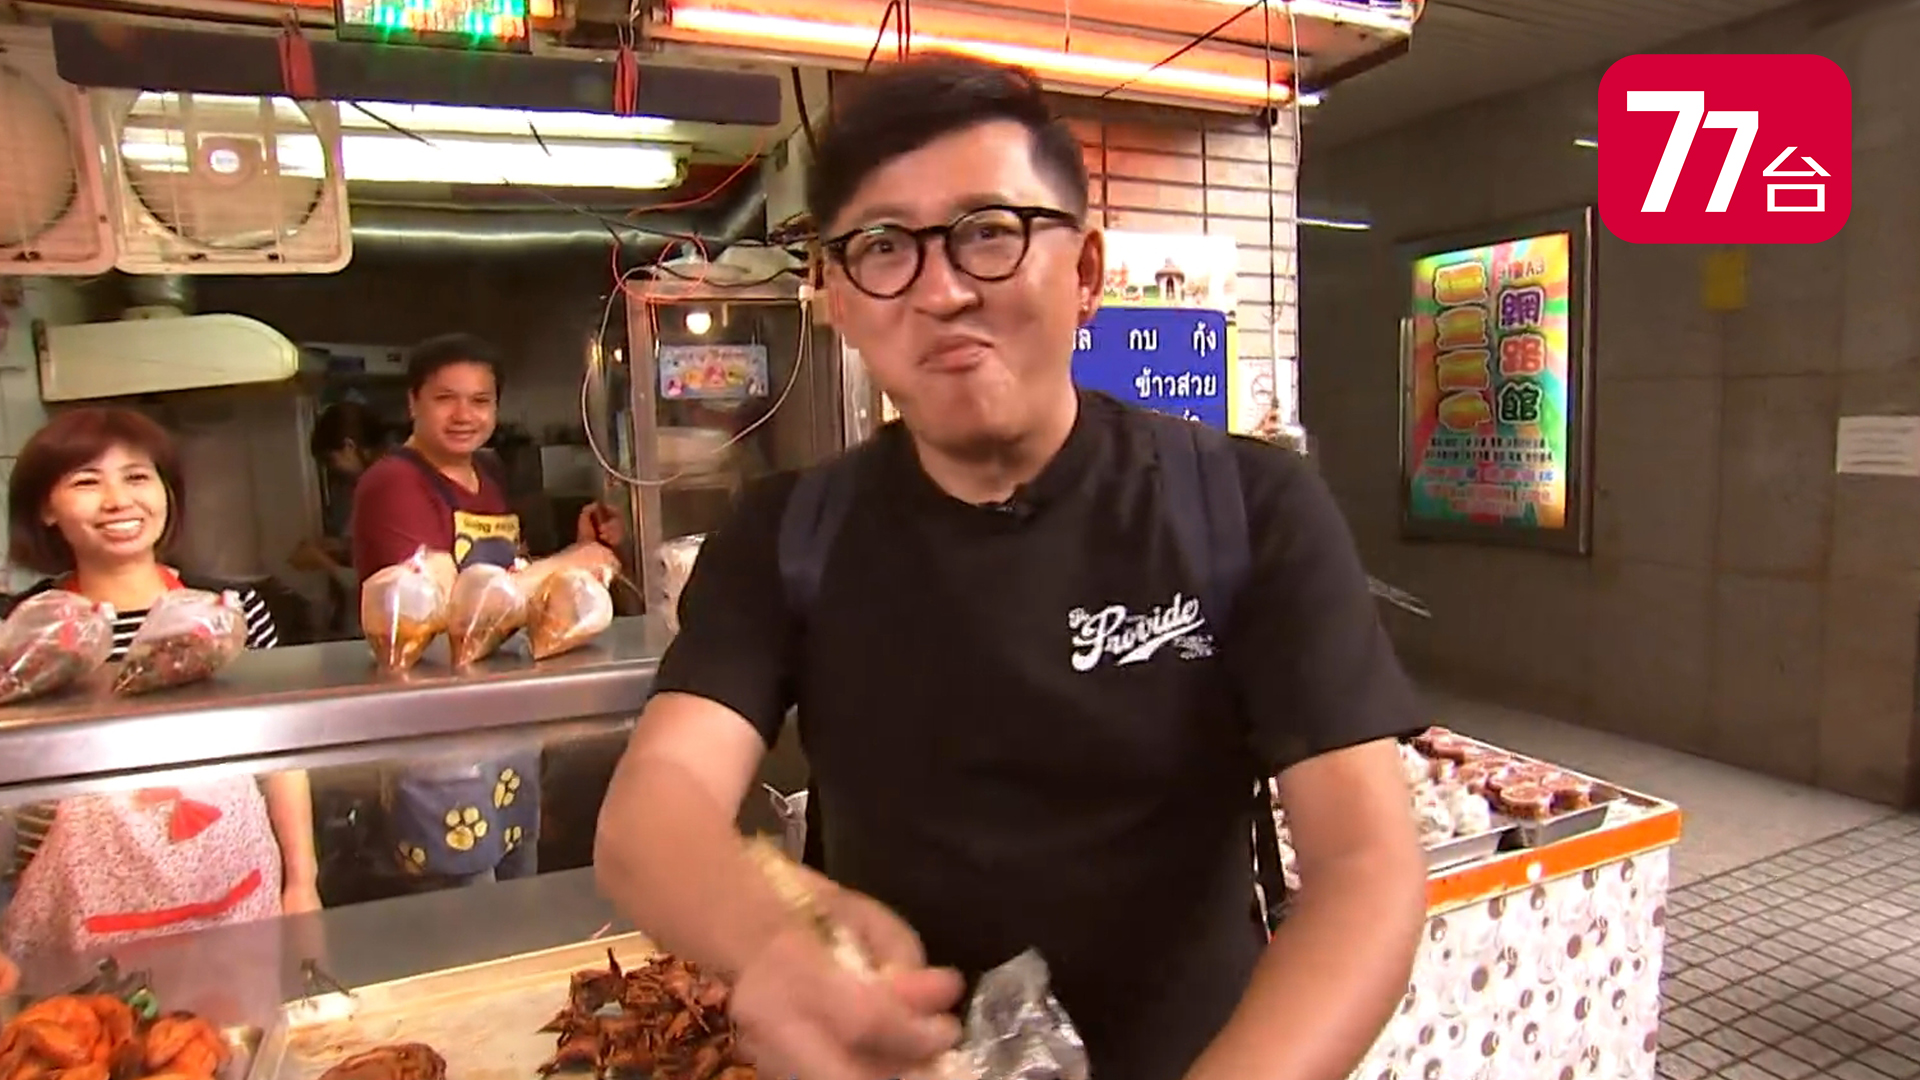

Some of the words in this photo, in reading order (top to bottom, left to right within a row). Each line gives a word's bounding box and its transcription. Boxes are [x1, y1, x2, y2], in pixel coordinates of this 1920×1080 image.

[1129, 328, 1158, 350] กบ
[1193, 320, 1217, 357] กุ้ง
[1135, 366, 1217, 398] ข้าวสวย
[1072, 592, 1205, 671] Provide
